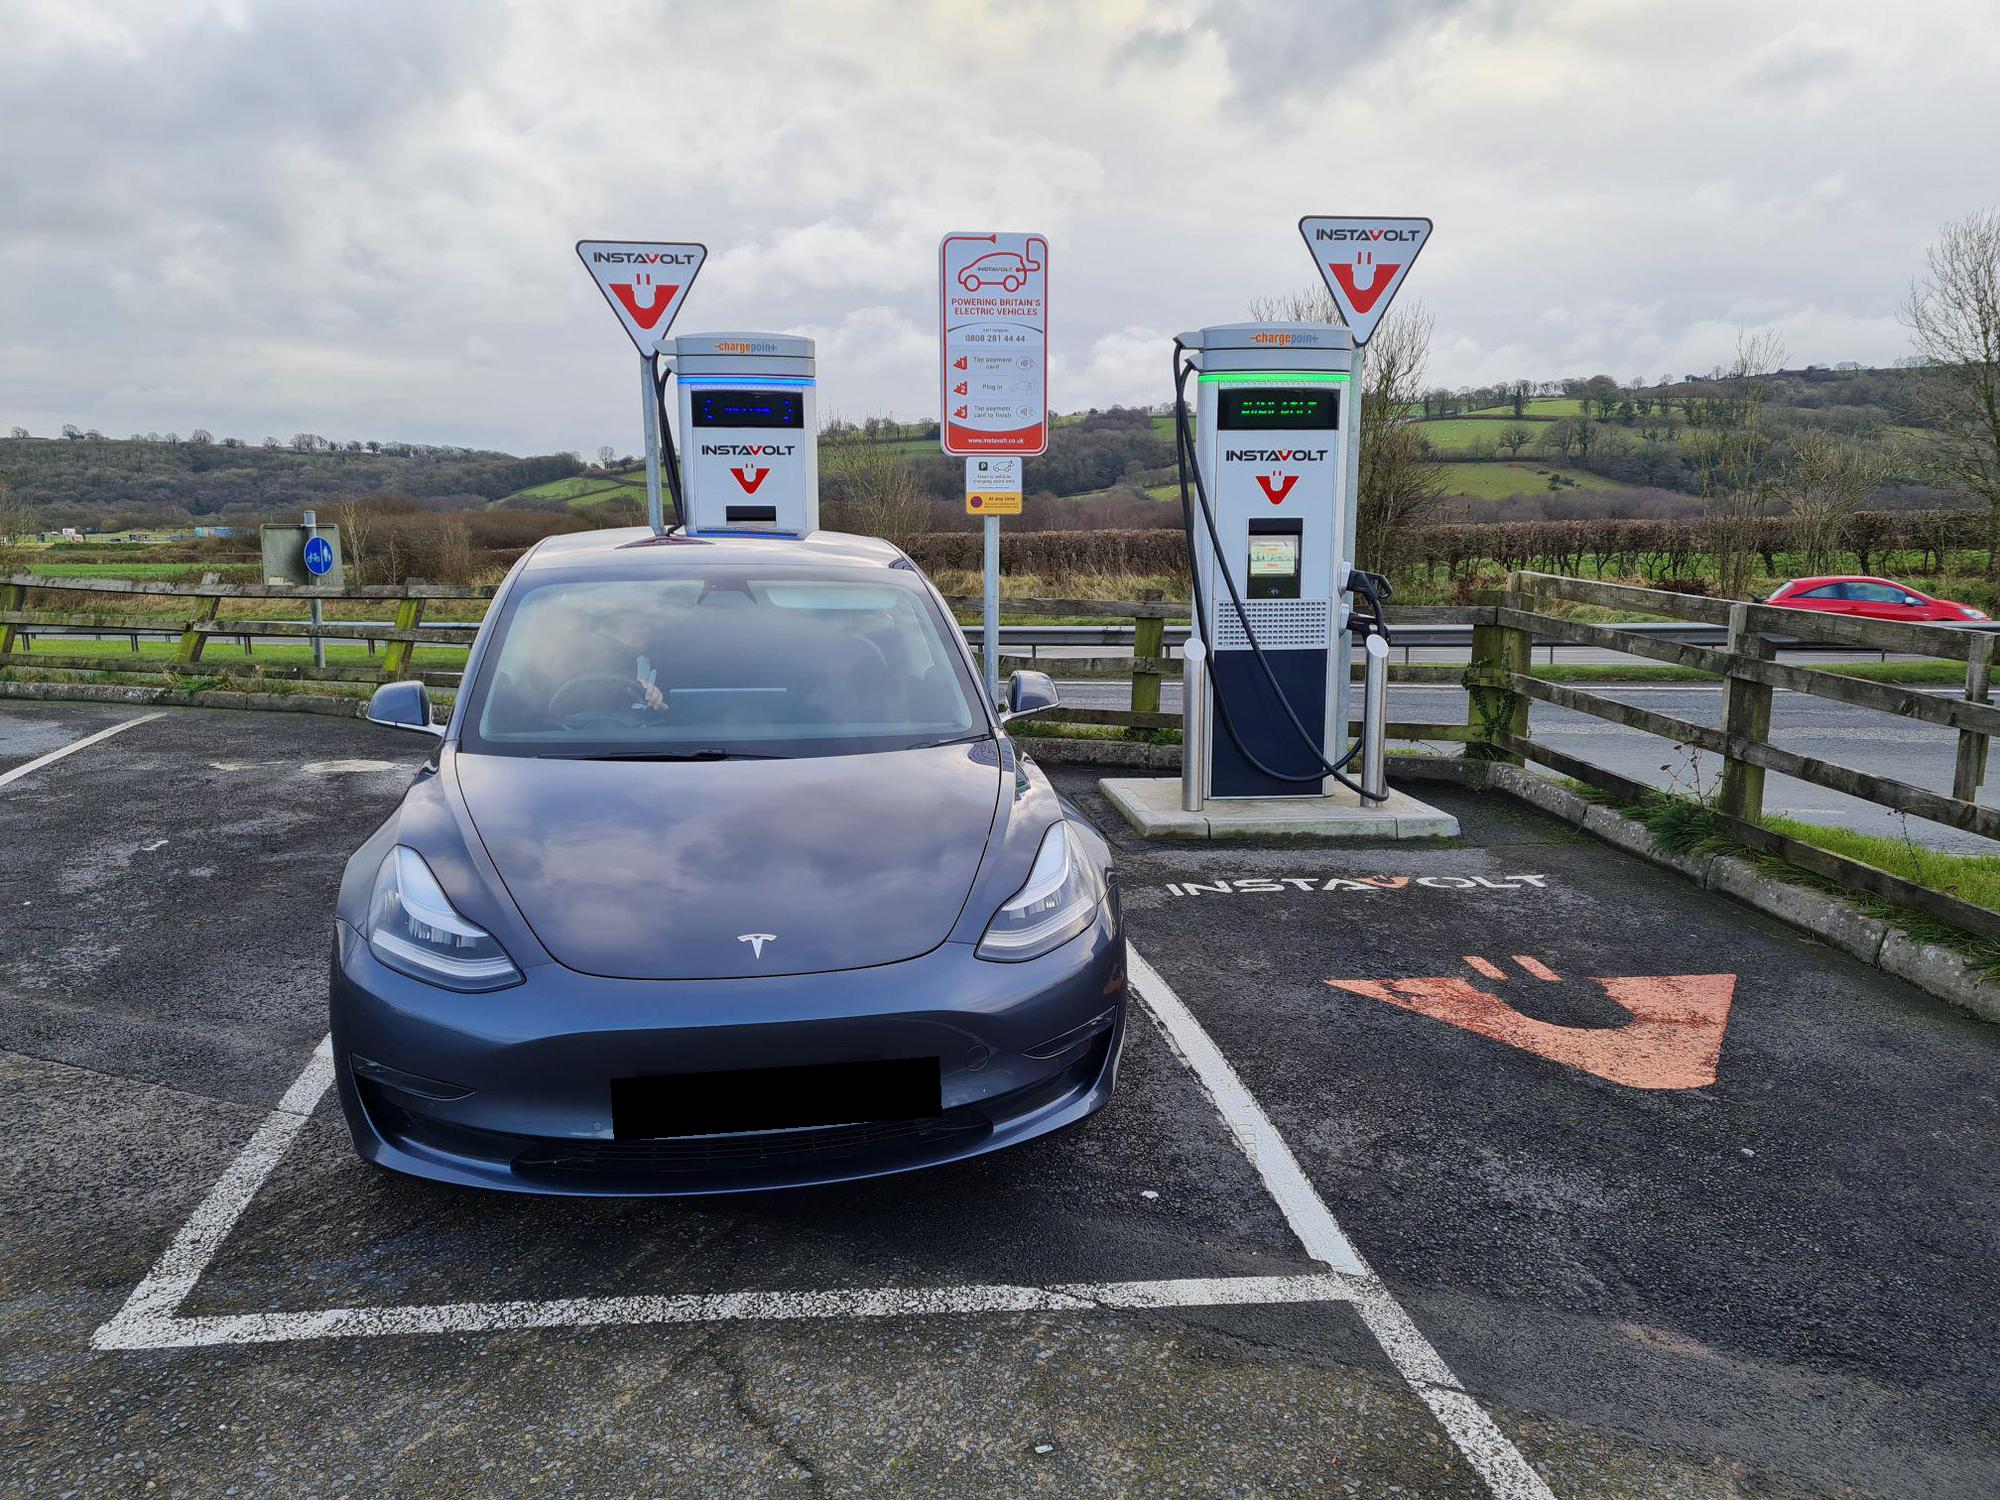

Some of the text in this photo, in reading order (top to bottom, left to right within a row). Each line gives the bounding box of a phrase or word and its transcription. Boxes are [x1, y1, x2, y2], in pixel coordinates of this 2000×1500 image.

[1316, 228, 1420, 242] INSTAVOLT
[593, 252, 695, 265] INSTAVOLT
[951, 298, 1041, 306] POWERING BRITAIN'S
[954, 307, 1038, 316] ELECTRIC VEHICLES
[702, 444, 796, 456] INSTAVOLT
[1225, 449, 1329, 462] INSTAVOLT
[1165, 874, 1549, 897] INSTAVOLT
